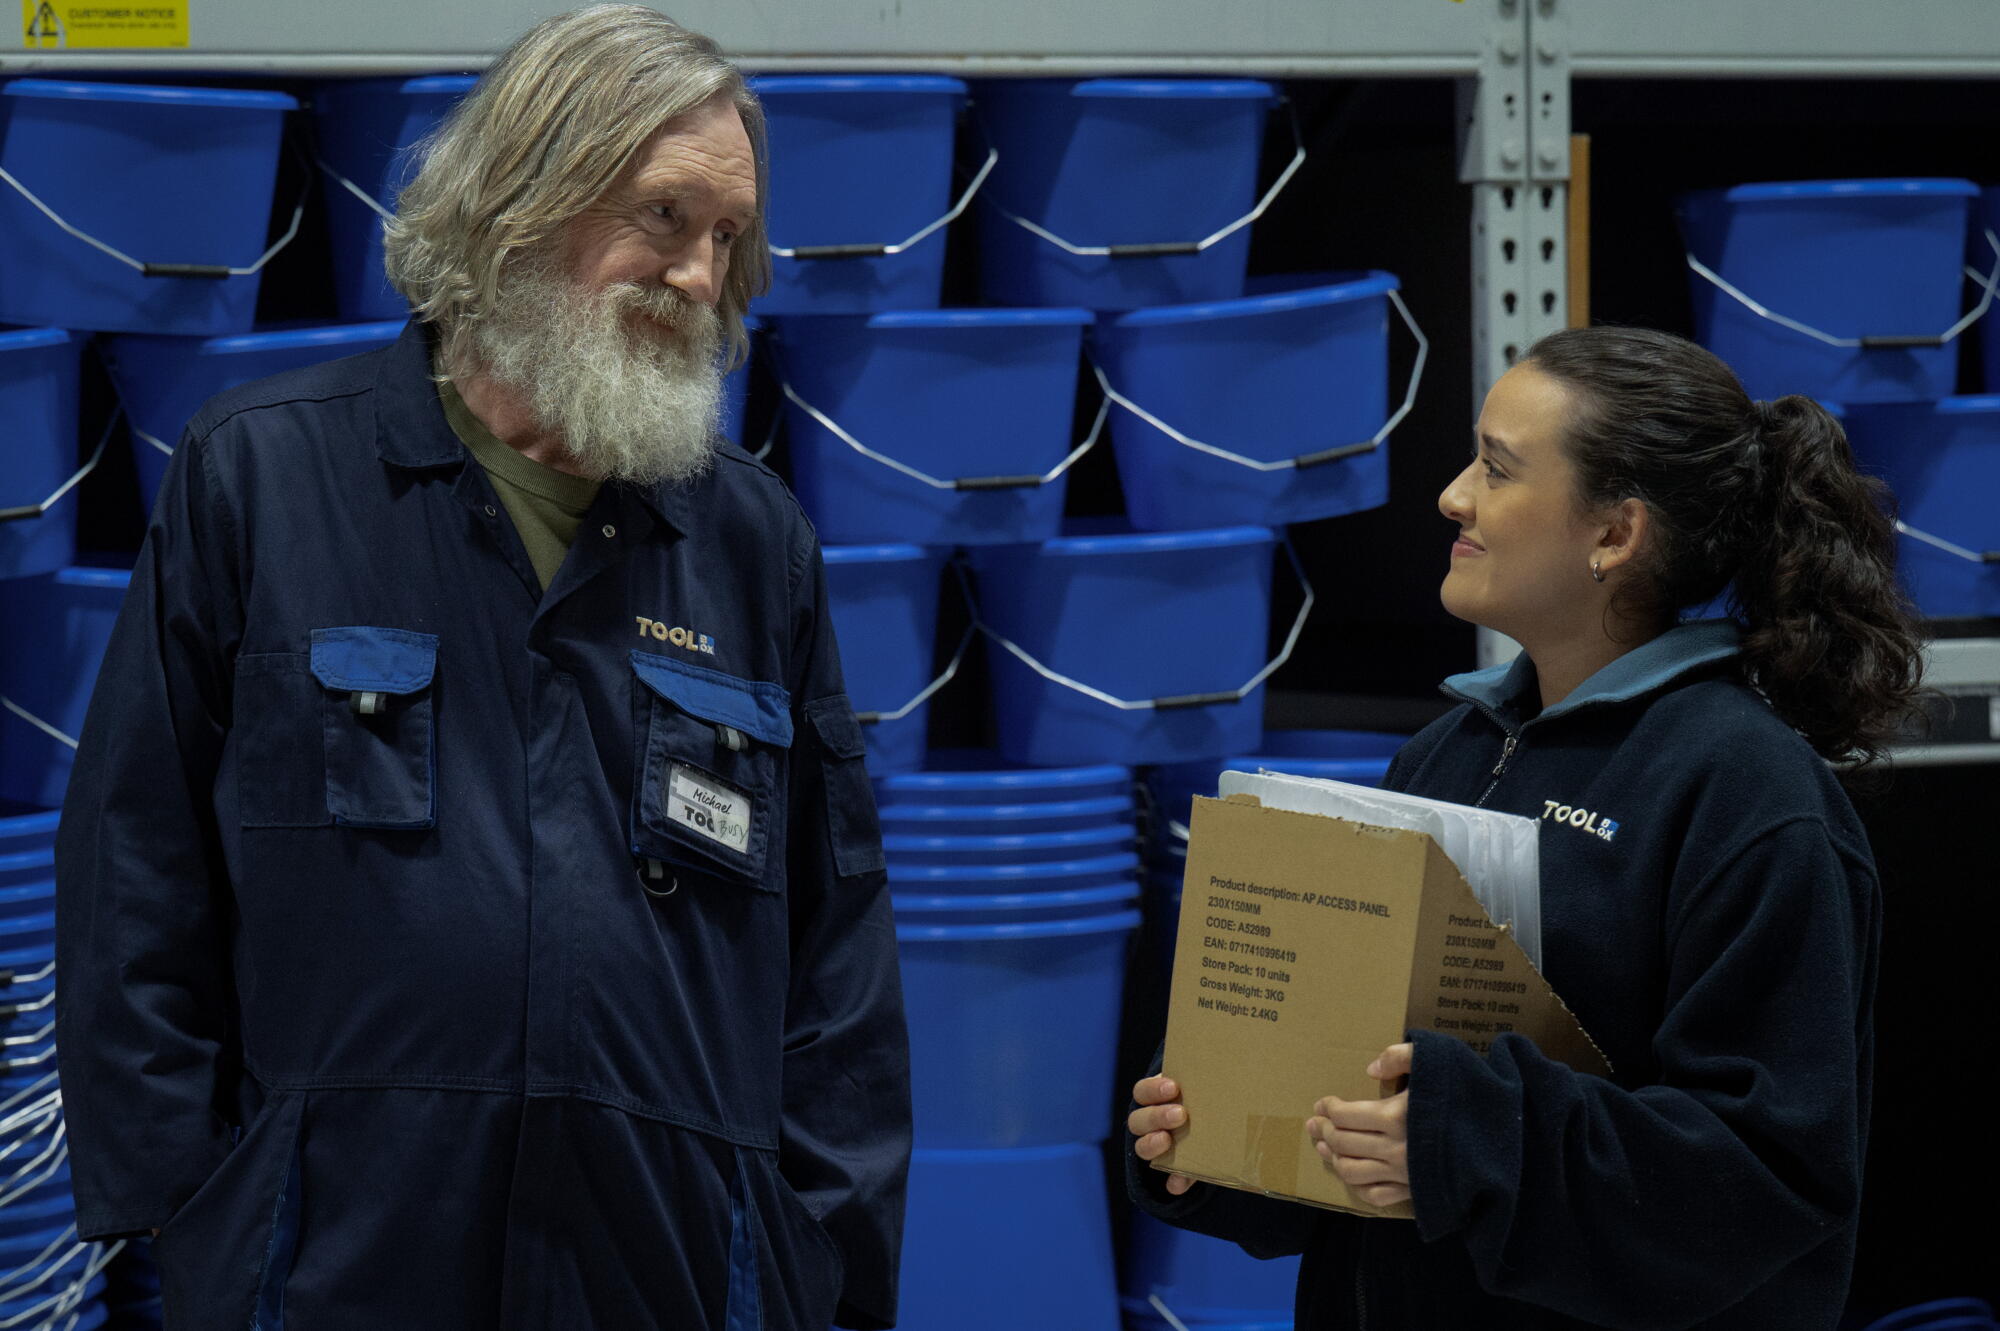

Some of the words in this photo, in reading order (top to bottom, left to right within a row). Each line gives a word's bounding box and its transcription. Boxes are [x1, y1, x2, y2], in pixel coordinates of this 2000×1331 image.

[68, 7, 130, 19] CUSTOMER
[134, 7, 176, 19] NOTICE
[636, 616, 698, 652] TOOL
[693, 787, 730, 814] Michael
[1542, 800, 1597, 833] TOOL
[1207, 896, 1261, 915] 230X150MM
[1210, 876, 1245, 892] Product
[1247, 882, 1300, 900] description:
[1302, 892, 1316, 904] AP
[1316, 895, 1357, 912] ACCESS
[1358, 901, 1390, 918] PANEL
[1205, 916, 1236, 931] CODE:
[1237, 922, 1271, 938] A52989
[1448, 914, 1482, 928] Product
[1203, 936, 1227, 949] EAN:
[1202, 956, 1226, 970] Store
[1228, 961, 1252, 976] Pack:
[1255, 966, 1266, 978] 10
[1267, 970, 1290, 983] units
[1442, 956, 1472, 969] CODE:
[1200, 976, 1227, 991] Gross
[1229, 981, 1262, 999] Weight:
[1264, 988, 1285, 1002] 3KG
[1440, 976, 1460, 988] EAN:
[1197, 996, 1214, 1010] Net
[1215, 1000, 1248, 1017] Weight:
[1250, 1006, 1278, 1022] 2.4KG
[1437, 996, 1459, 1009] Store
[1461, 998, 1485, 1011] Pack:
[1487, 1001, 1497, 1012] 10
[1498, 1001, 1520, 1015] units
[1434, 1017, 1459, 1030] Gross
[1461, 1020, 1492, 1034] Weight:
